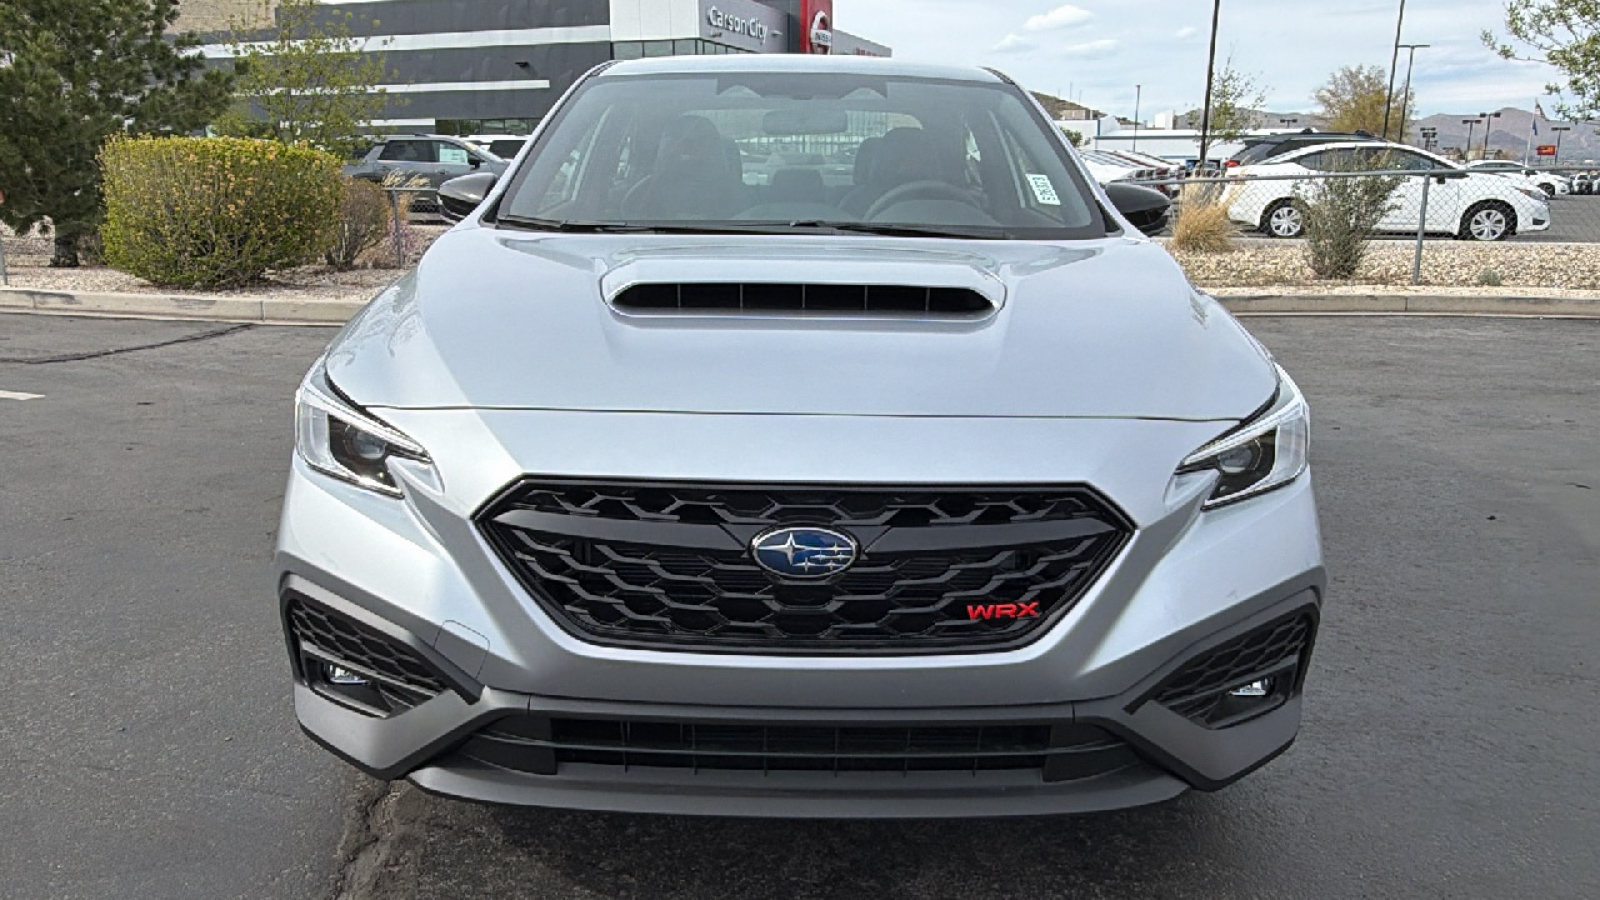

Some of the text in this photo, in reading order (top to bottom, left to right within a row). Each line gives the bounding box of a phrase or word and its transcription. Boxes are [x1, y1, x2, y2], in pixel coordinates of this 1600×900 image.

[709, 5, 768, 44] Carson City
[966, 601, 1040, 620] WRX
